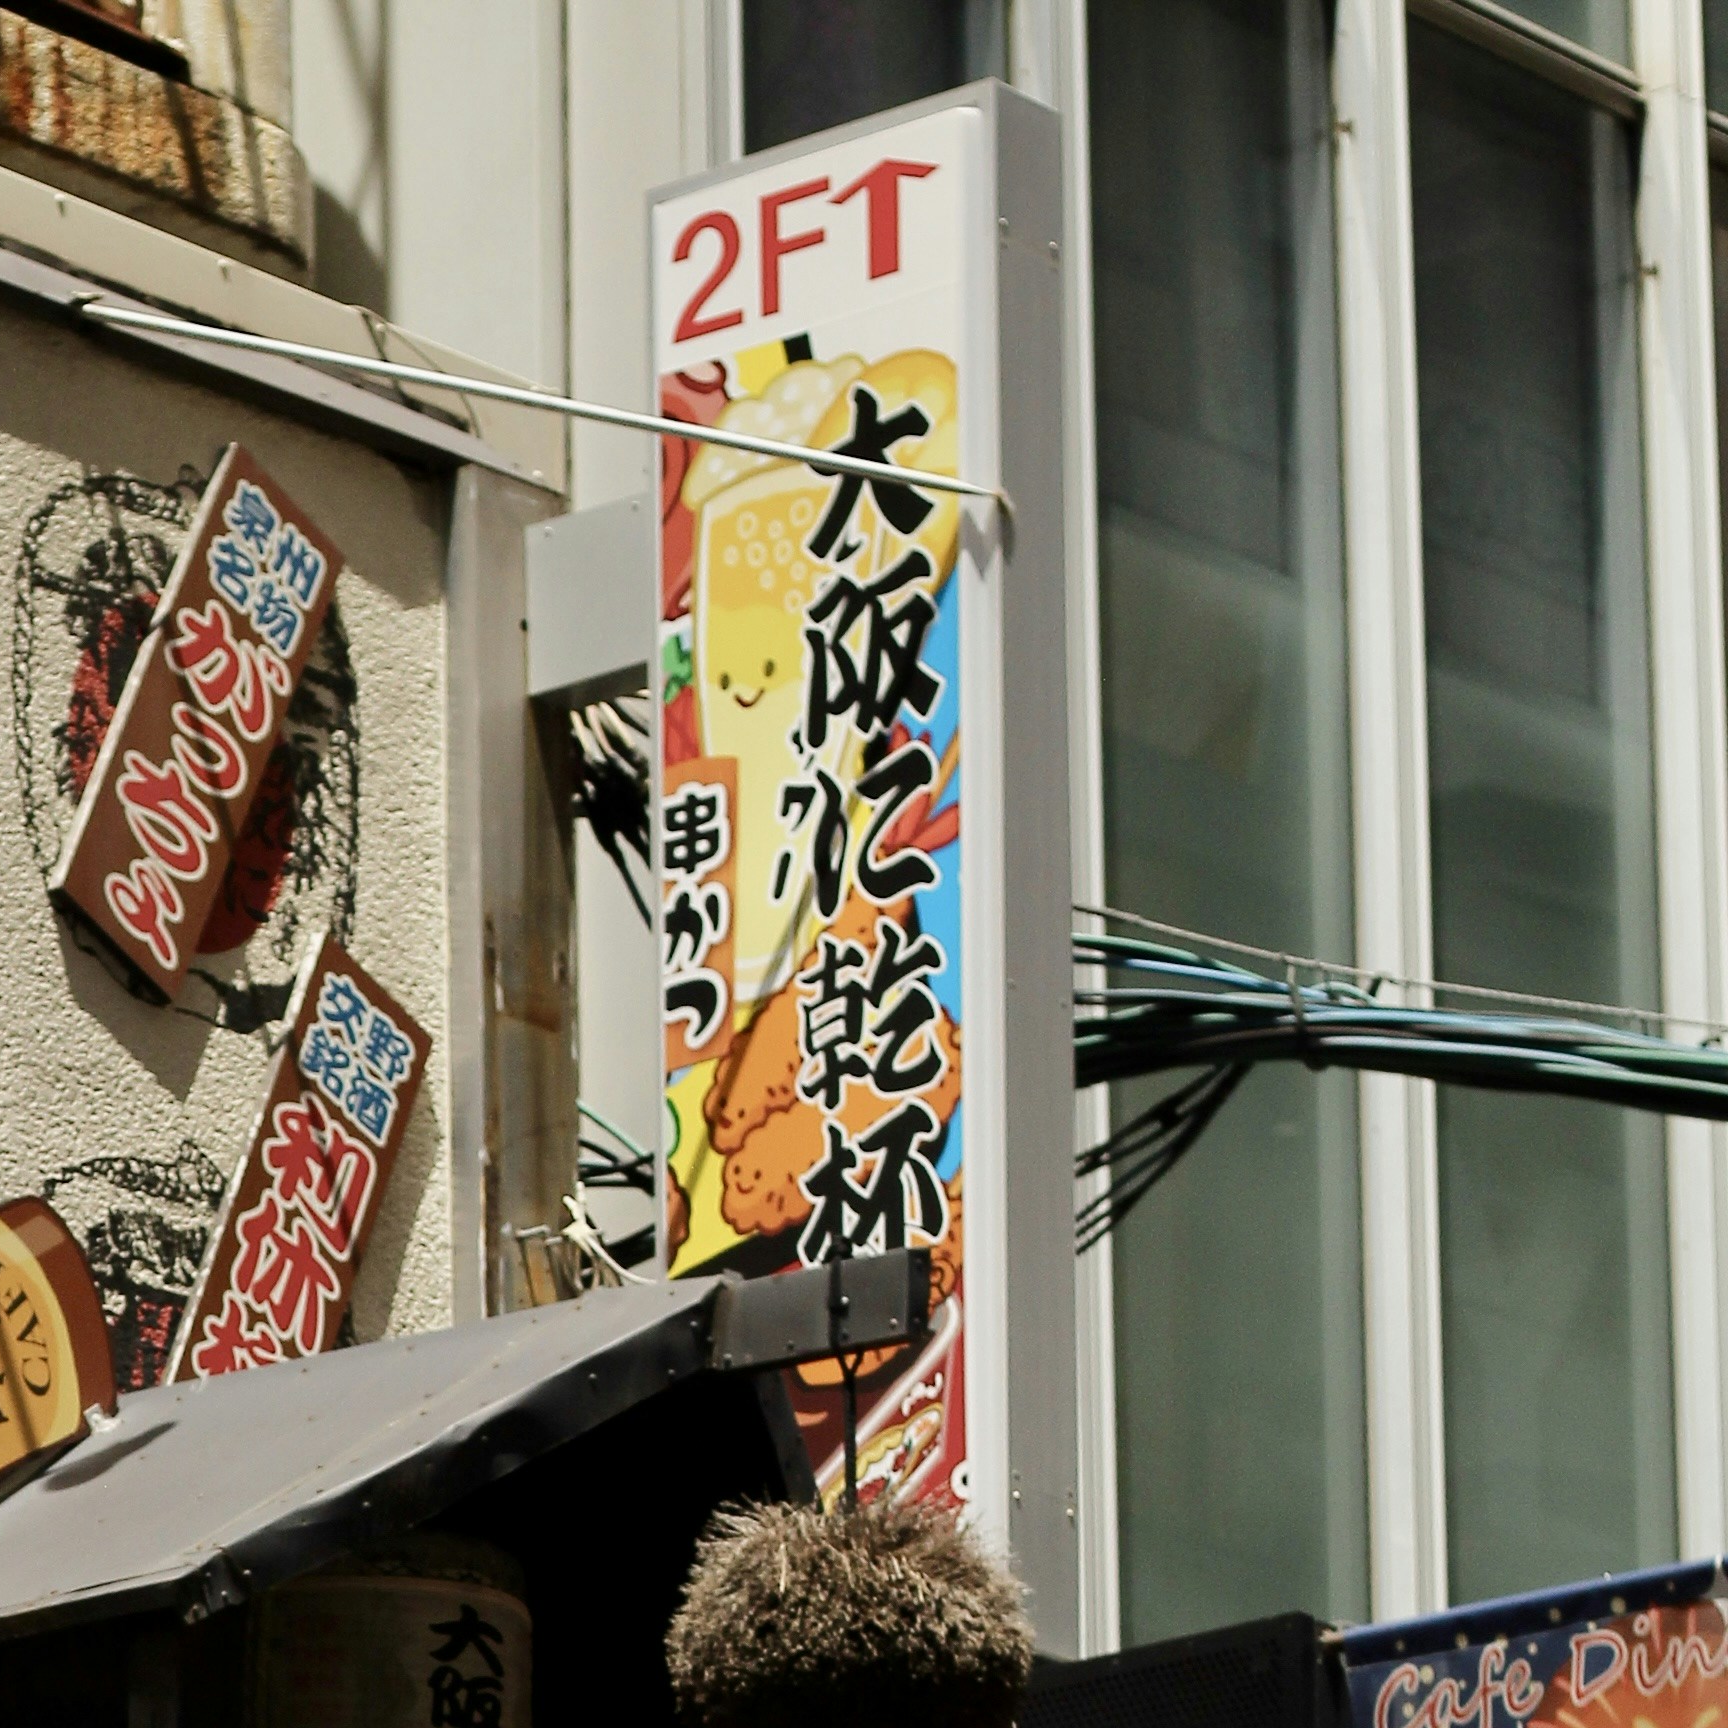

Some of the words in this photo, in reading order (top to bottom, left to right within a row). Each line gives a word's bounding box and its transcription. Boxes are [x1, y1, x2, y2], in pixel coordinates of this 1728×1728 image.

[671, 176, 831, 343] 2F
[208, 531, 299, 655] 名物
[223, 479, 328, 608] 泉州
[662, 781, 731, 1052] 串かつ
